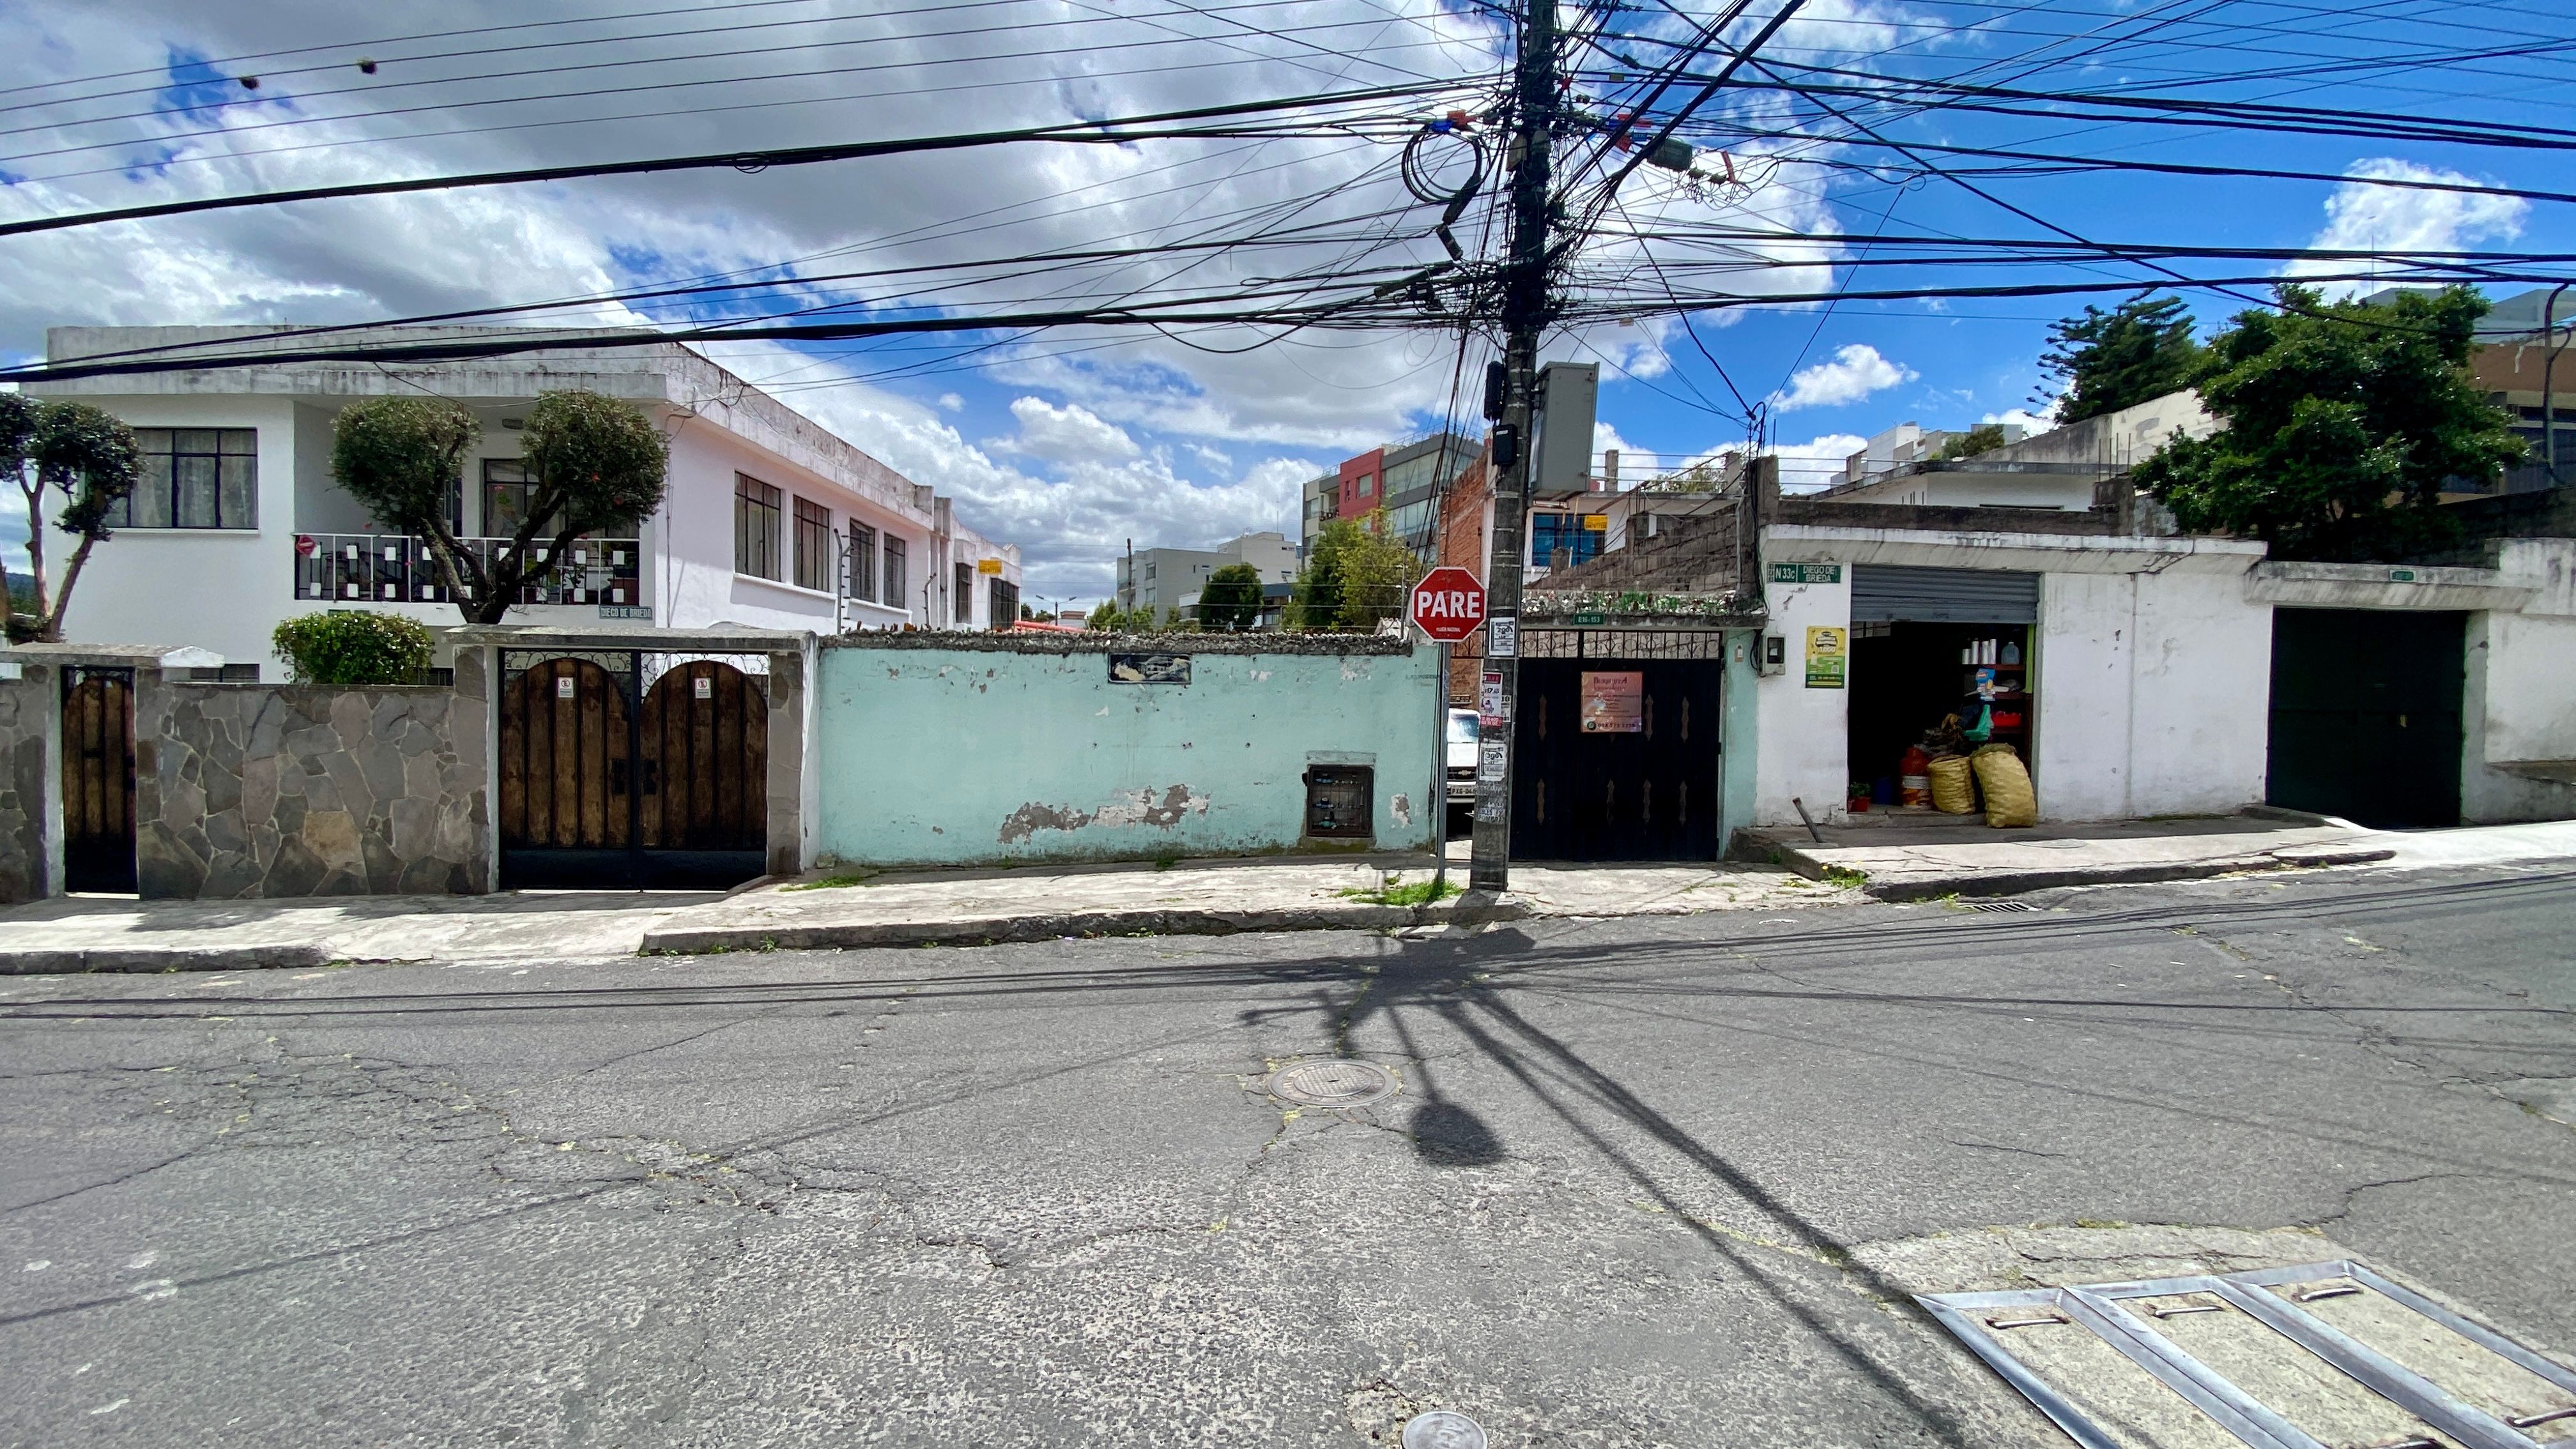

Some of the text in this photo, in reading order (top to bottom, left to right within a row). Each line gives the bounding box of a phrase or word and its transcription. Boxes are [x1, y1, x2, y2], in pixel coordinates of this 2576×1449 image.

[1775, 567, 1782, 579] N
[1803, 565, 1836, 574] DIEGO DE
[1418, 590, 1480, 618] PARE
[601, 608, 619, 617] DIEGO
[620, 608, 628, 617] DE
